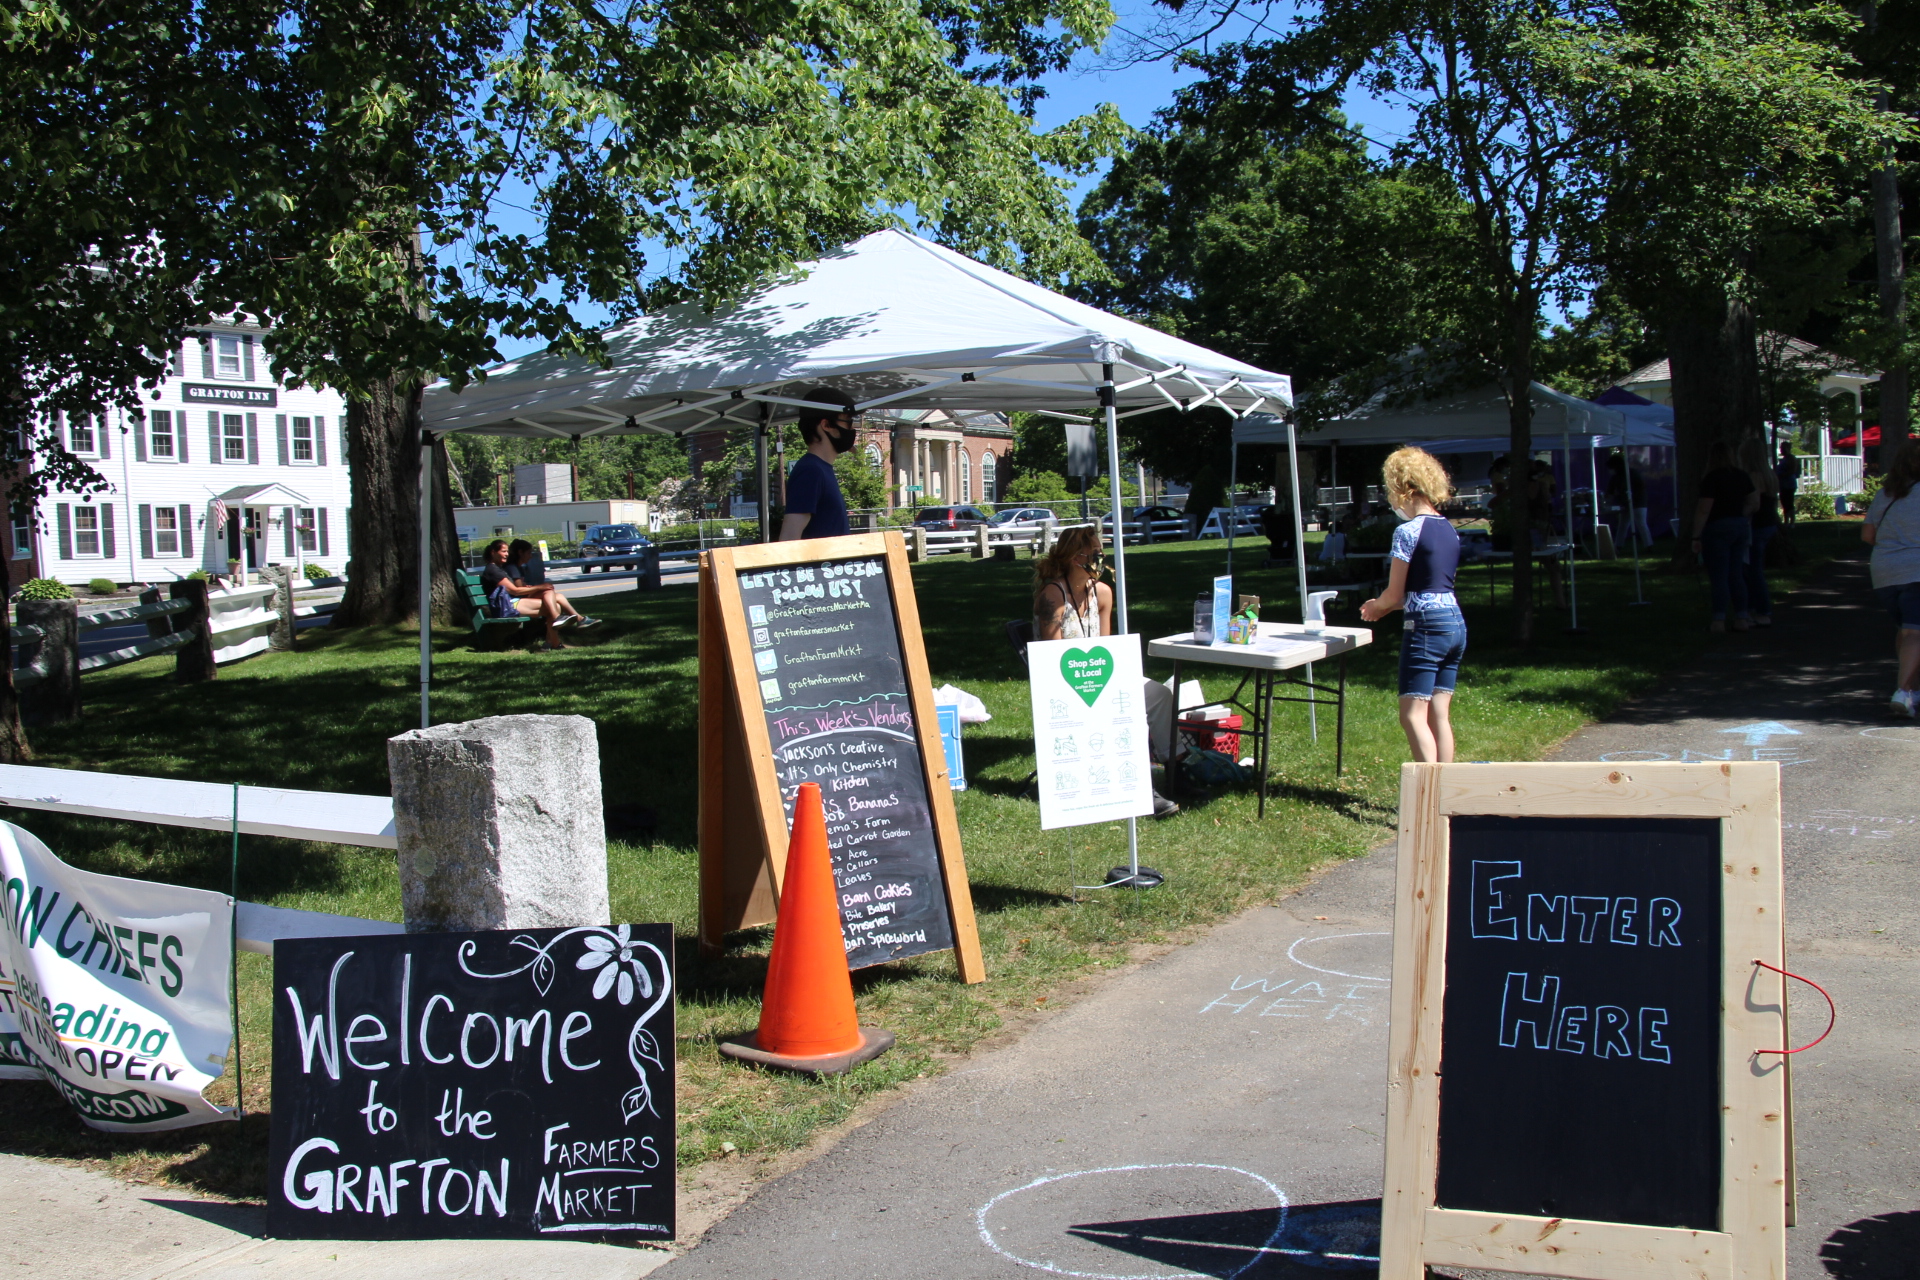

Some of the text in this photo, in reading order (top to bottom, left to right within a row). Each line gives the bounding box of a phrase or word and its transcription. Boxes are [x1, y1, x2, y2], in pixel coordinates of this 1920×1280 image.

[190, 387, 270, 401] GRAFTON INN
[741, 559, 883, 589] LET'S BE SOCIAL
[828, 579, 863, 599] US!
[1067, 657, 1107, 670] Shop Safe
[1074, 667, 1102, 678] & Local
[773, 717, 810, 739] This
[815, 711, 868, 733] Week's
[840, 741, 885, 756] Creative
[814, 763, 838, 777] Only
[842, 757, 898, 773] Chemistry
[832, 776, 869, 792] Kitchen
[848, 794, 899, 812] Bananas
[847, 831, 878, 846] Carrot
[882, 828, 911, 840] Garden
[847, 857, 879, 872] Cellars
[848, 849, 868, 861] Acre
[836, 872, 872, 889] Leaves
[842, 892, 871, 907] Barn
[874, 882, 912, 900] Cookies
[1471, 860, 1682, 947] ENTER
[845, 901, 896, 921] Bite Bakery
[848, 915, 890, 936] Preserves
[867, 929, 927, 949] Spiceworld
[56, 901, 183, 998] CHIEFS
[286, 951, 601, 1084] Welcome
[1499, 971, 1671, 1064] HERE
[75, 1047, 184, 1082] OPEN
[360, 1080, 497, 1140] to the
[544, 1122, 660, 1169] FARMERS
[283, 1137, 509, 1218] GRAFTON
[535, 1172, 653, 1221] MARKET
